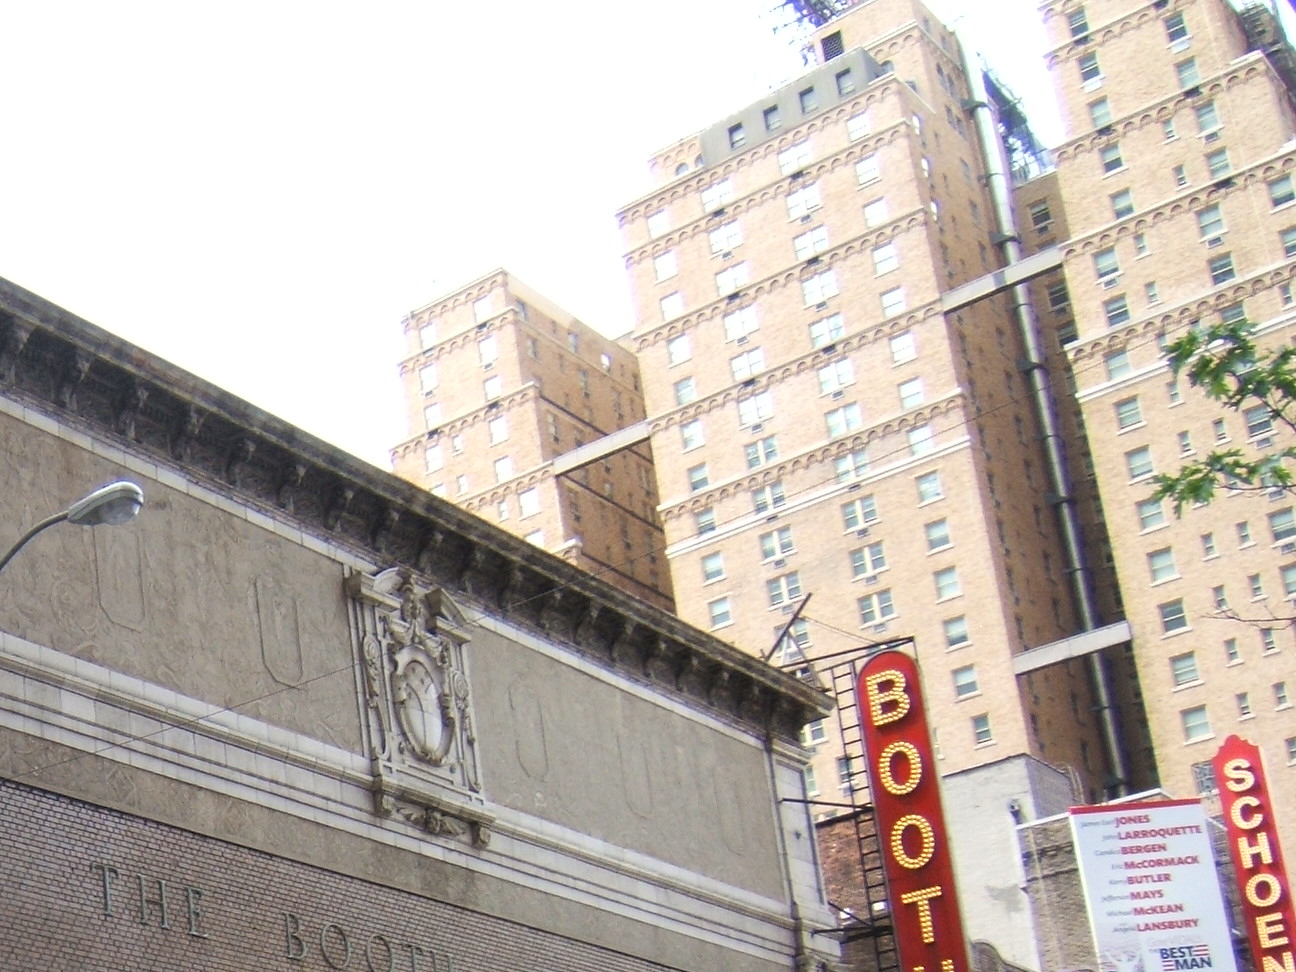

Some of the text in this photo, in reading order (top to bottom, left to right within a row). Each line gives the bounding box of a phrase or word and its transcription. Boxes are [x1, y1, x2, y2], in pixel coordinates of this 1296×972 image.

[1115, 814, 1150, 828] JONES
[1118, 825, 1202, 840] LARROQUETTE
[1120, 843, 1167, 855] BERGEN
[1124, 855, 1200, 870] McCORMACK
[1127, 873, 1172, 885] BUTLER
[90, 864, 210, 938] THE
[1130, 889, 1164, 900] MAYS
[1134, 903, 1184, 916] McKEAN
[1136, 918, 1200, 933] LANSBURY
[1159, 945, 1195, 960] BEST
[1174, 956, 1213, 971] MAN
